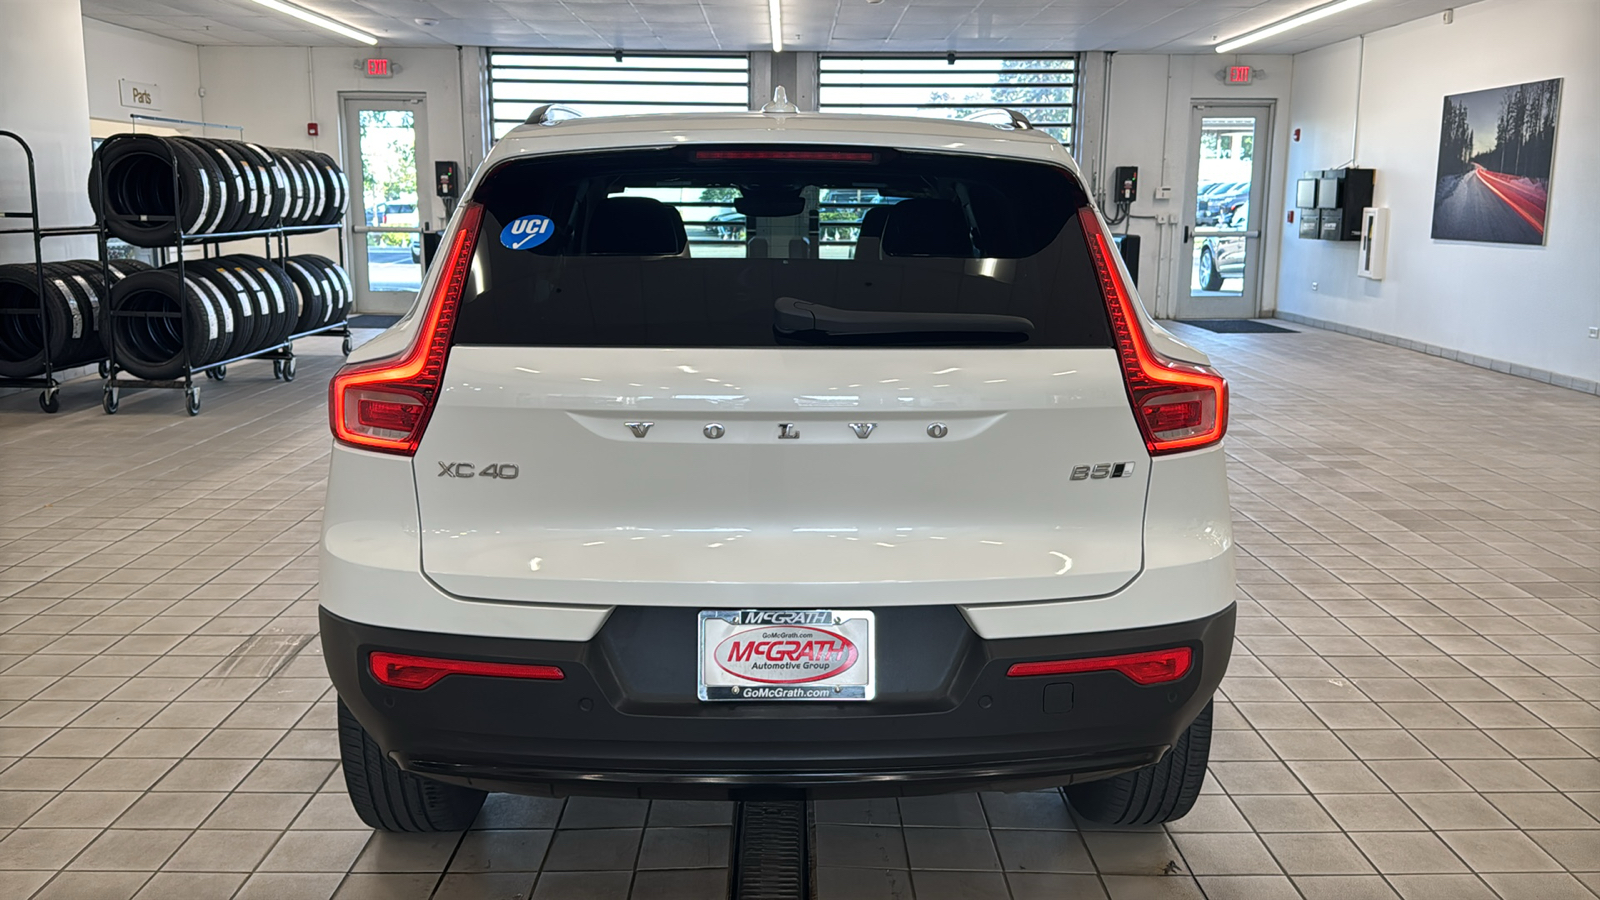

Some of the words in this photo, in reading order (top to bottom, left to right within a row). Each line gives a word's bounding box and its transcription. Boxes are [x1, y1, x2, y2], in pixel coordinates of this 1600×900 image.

[368, 59, 387, 75] EXIT
[1230, 66, 1250, 82] EXIT
[132, 87, 152, 104] Parts
[511, 218, 550, 235] UCI
[624, 421, 949, 440] VOLVO
[1069, 463, 1111, 481] B5
[751, 662, 801, 670] Automotive
[803, 662, 830, 671] Group
[742, 687, 830, 699] GoMcGrath.com
